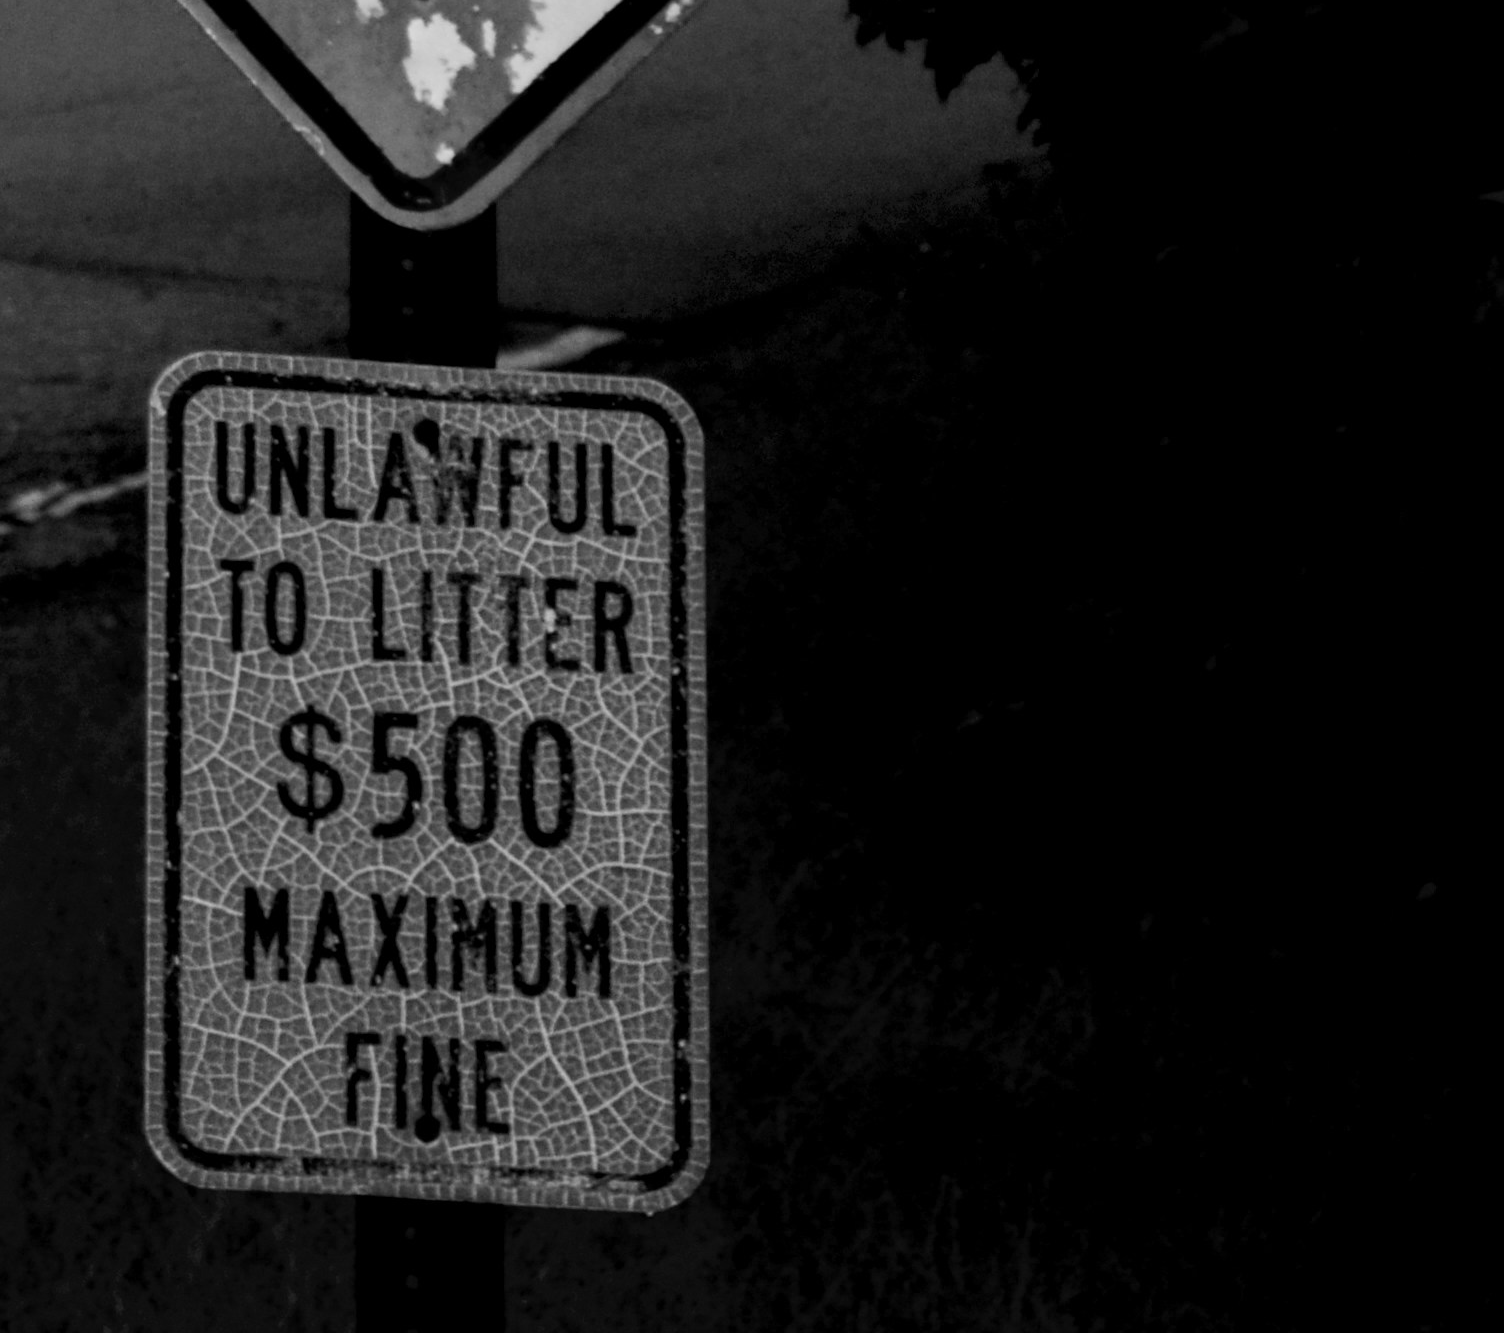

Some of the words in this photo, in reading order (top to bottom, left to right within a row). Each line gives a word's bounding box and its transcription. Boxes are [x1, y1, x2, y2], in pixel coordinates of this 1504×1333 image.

[214, 420, 637, 537] UNLAWFUL
[219, 558, 308, 656] TO
[371, 567, 635, 675] LITTER
[275, 705, 575, 848] $500
[243, 886, 614, 1000] MAXIMUM
[345, 1032, 511, 1136] FINE
